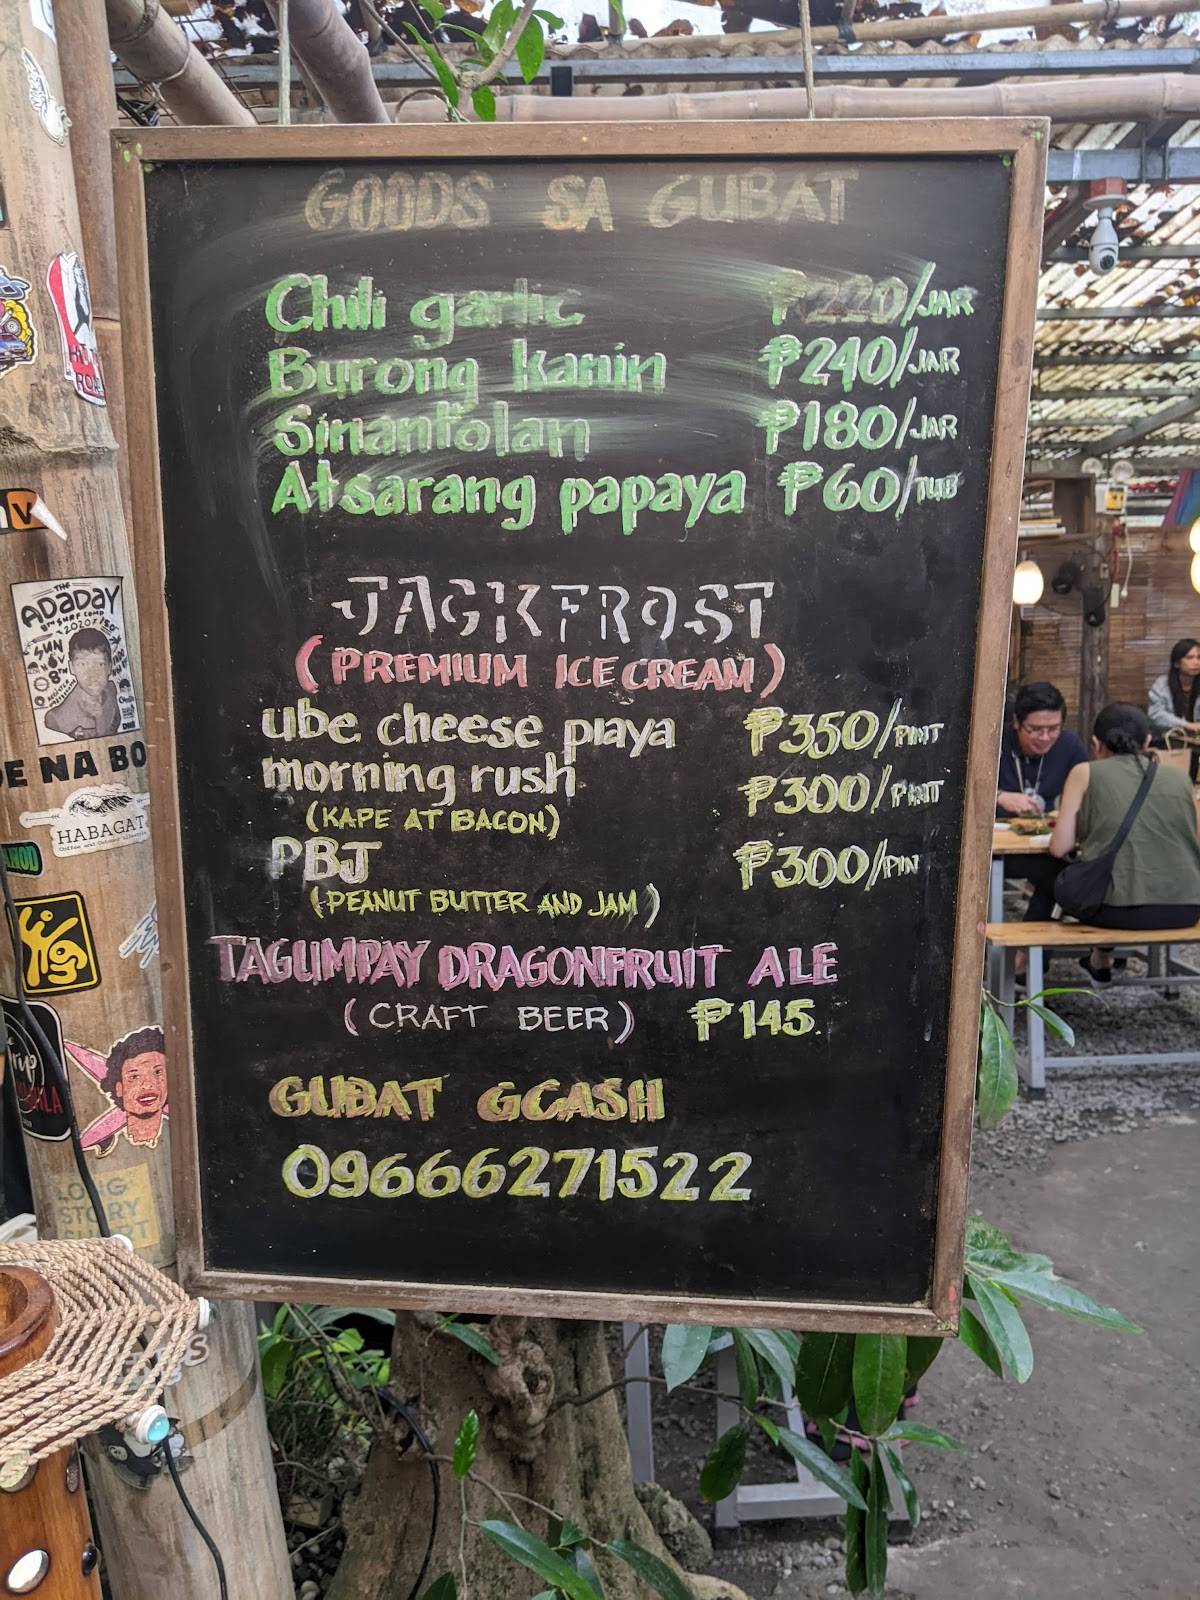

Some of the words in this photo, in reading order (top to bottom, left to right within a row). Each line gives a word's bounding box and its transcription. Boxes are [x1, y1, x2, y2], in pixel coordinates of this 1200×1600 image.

[305, 168, 495, 231] GOODS
[543, 174, 615, 232] SA
[647, 167, 859, 228] GUBAT
[265, 273, 387, 332] Chili
[410, 278, 585, 349] garlic
[267, 347, 479, 413] Burong
[511, 338, 667, 394] kanin
[273, 401, 590, 461] Sinantolan
[272, 459, 536, 531] Atsarang
[559, 470, 747, 535] papaya
[54, 582, 70, 591] THE
[34, 639, 63, 661] SUN
[64, 617, 92, 635] 2020
[48, 668, 68, 684] 8TH
[555, 654, 620, 690] ICE
[261, 698, 362, 745] ube
[376, 703, 544, 748] cheese
[39, 750, 99, 784] NA
[261, 753, 456, 806] morning
[471, 752, 577, 798] rush
[57, 815, 145, 844] HABAGAT
[403, 809, 443, 831] AT
[271, 836, 383, 884] PBJ
[429, 889, 529, 917] BUTTER
[536, 890, 583, 916] AND
[210, 935, 430, 990] TAGUMPAY
[438, 943, 731, 990] DRAGONFRUIT
[747, 942, 839, 987] ALE
[269, 1075, 450, 1120] GUBAT
[477, 1078, 667, 1123] GCASH
[282, 1144, 753, 1201] 09666271522
